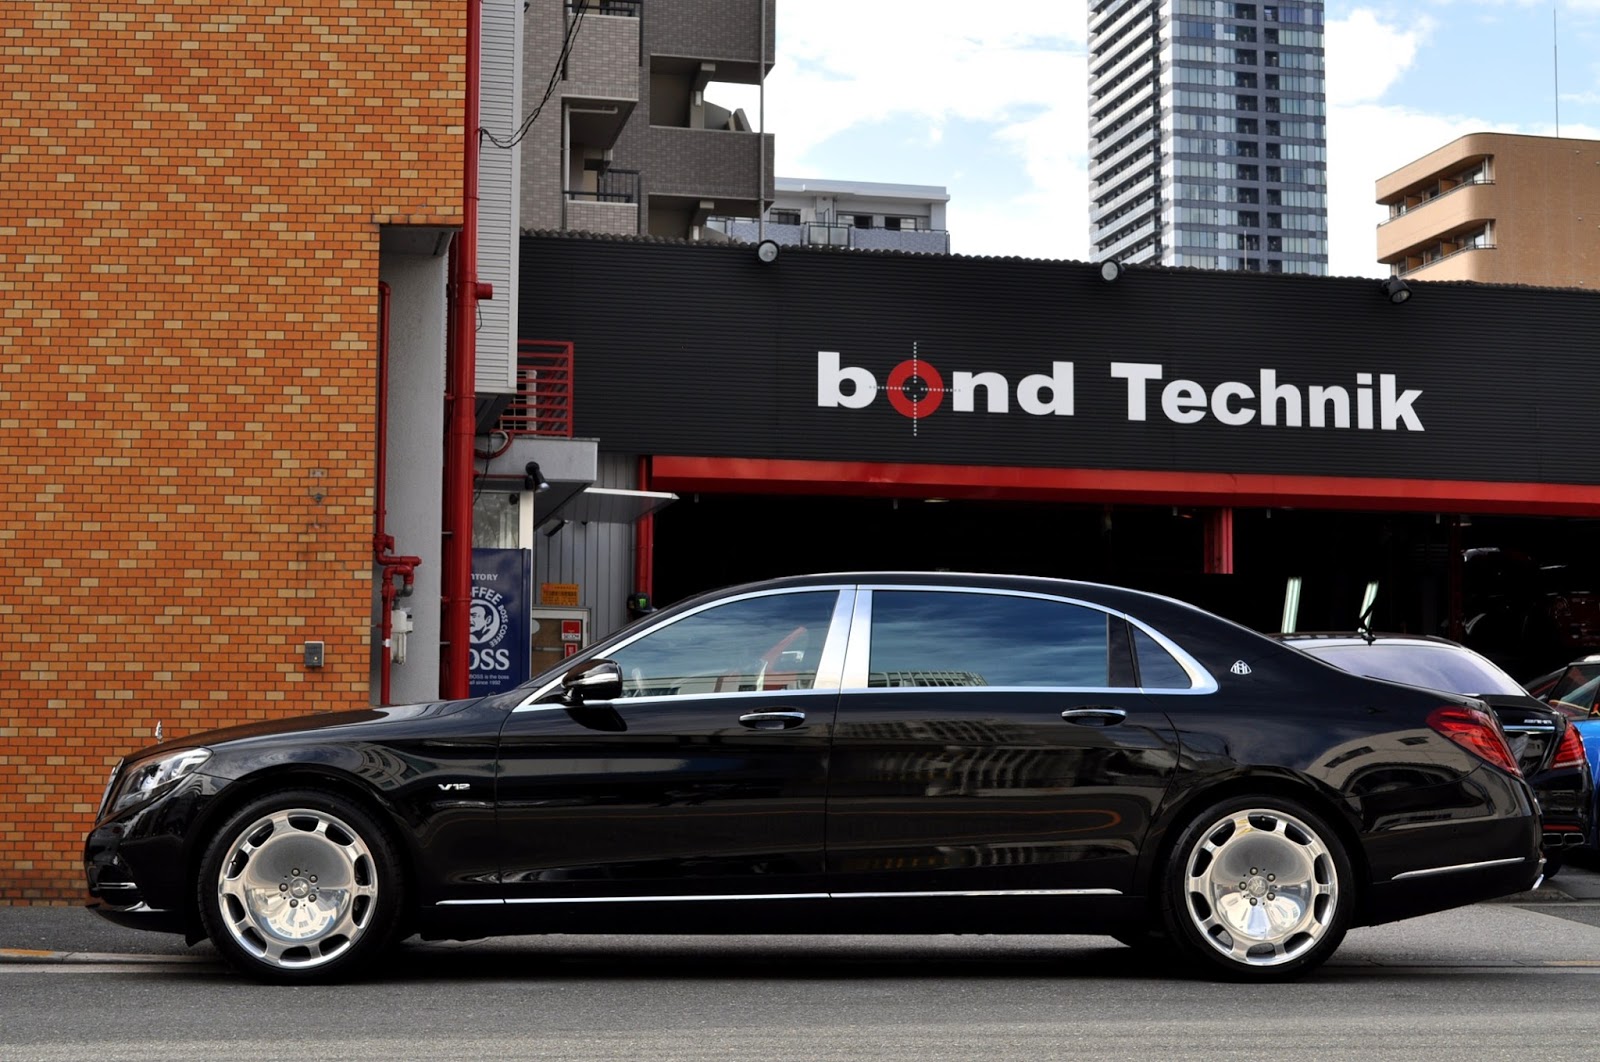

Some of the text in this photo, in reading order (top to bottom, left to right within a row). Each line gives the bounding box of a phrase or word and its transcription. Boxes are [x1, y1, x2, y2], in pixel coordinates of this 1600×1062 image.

[818, 351, 1425, 431] bond Technik
[471, 586, 503, 605] FFEE
[489, 604, 508, 647] BOSS COFFEE
[438, 783, 471, 791] V12
